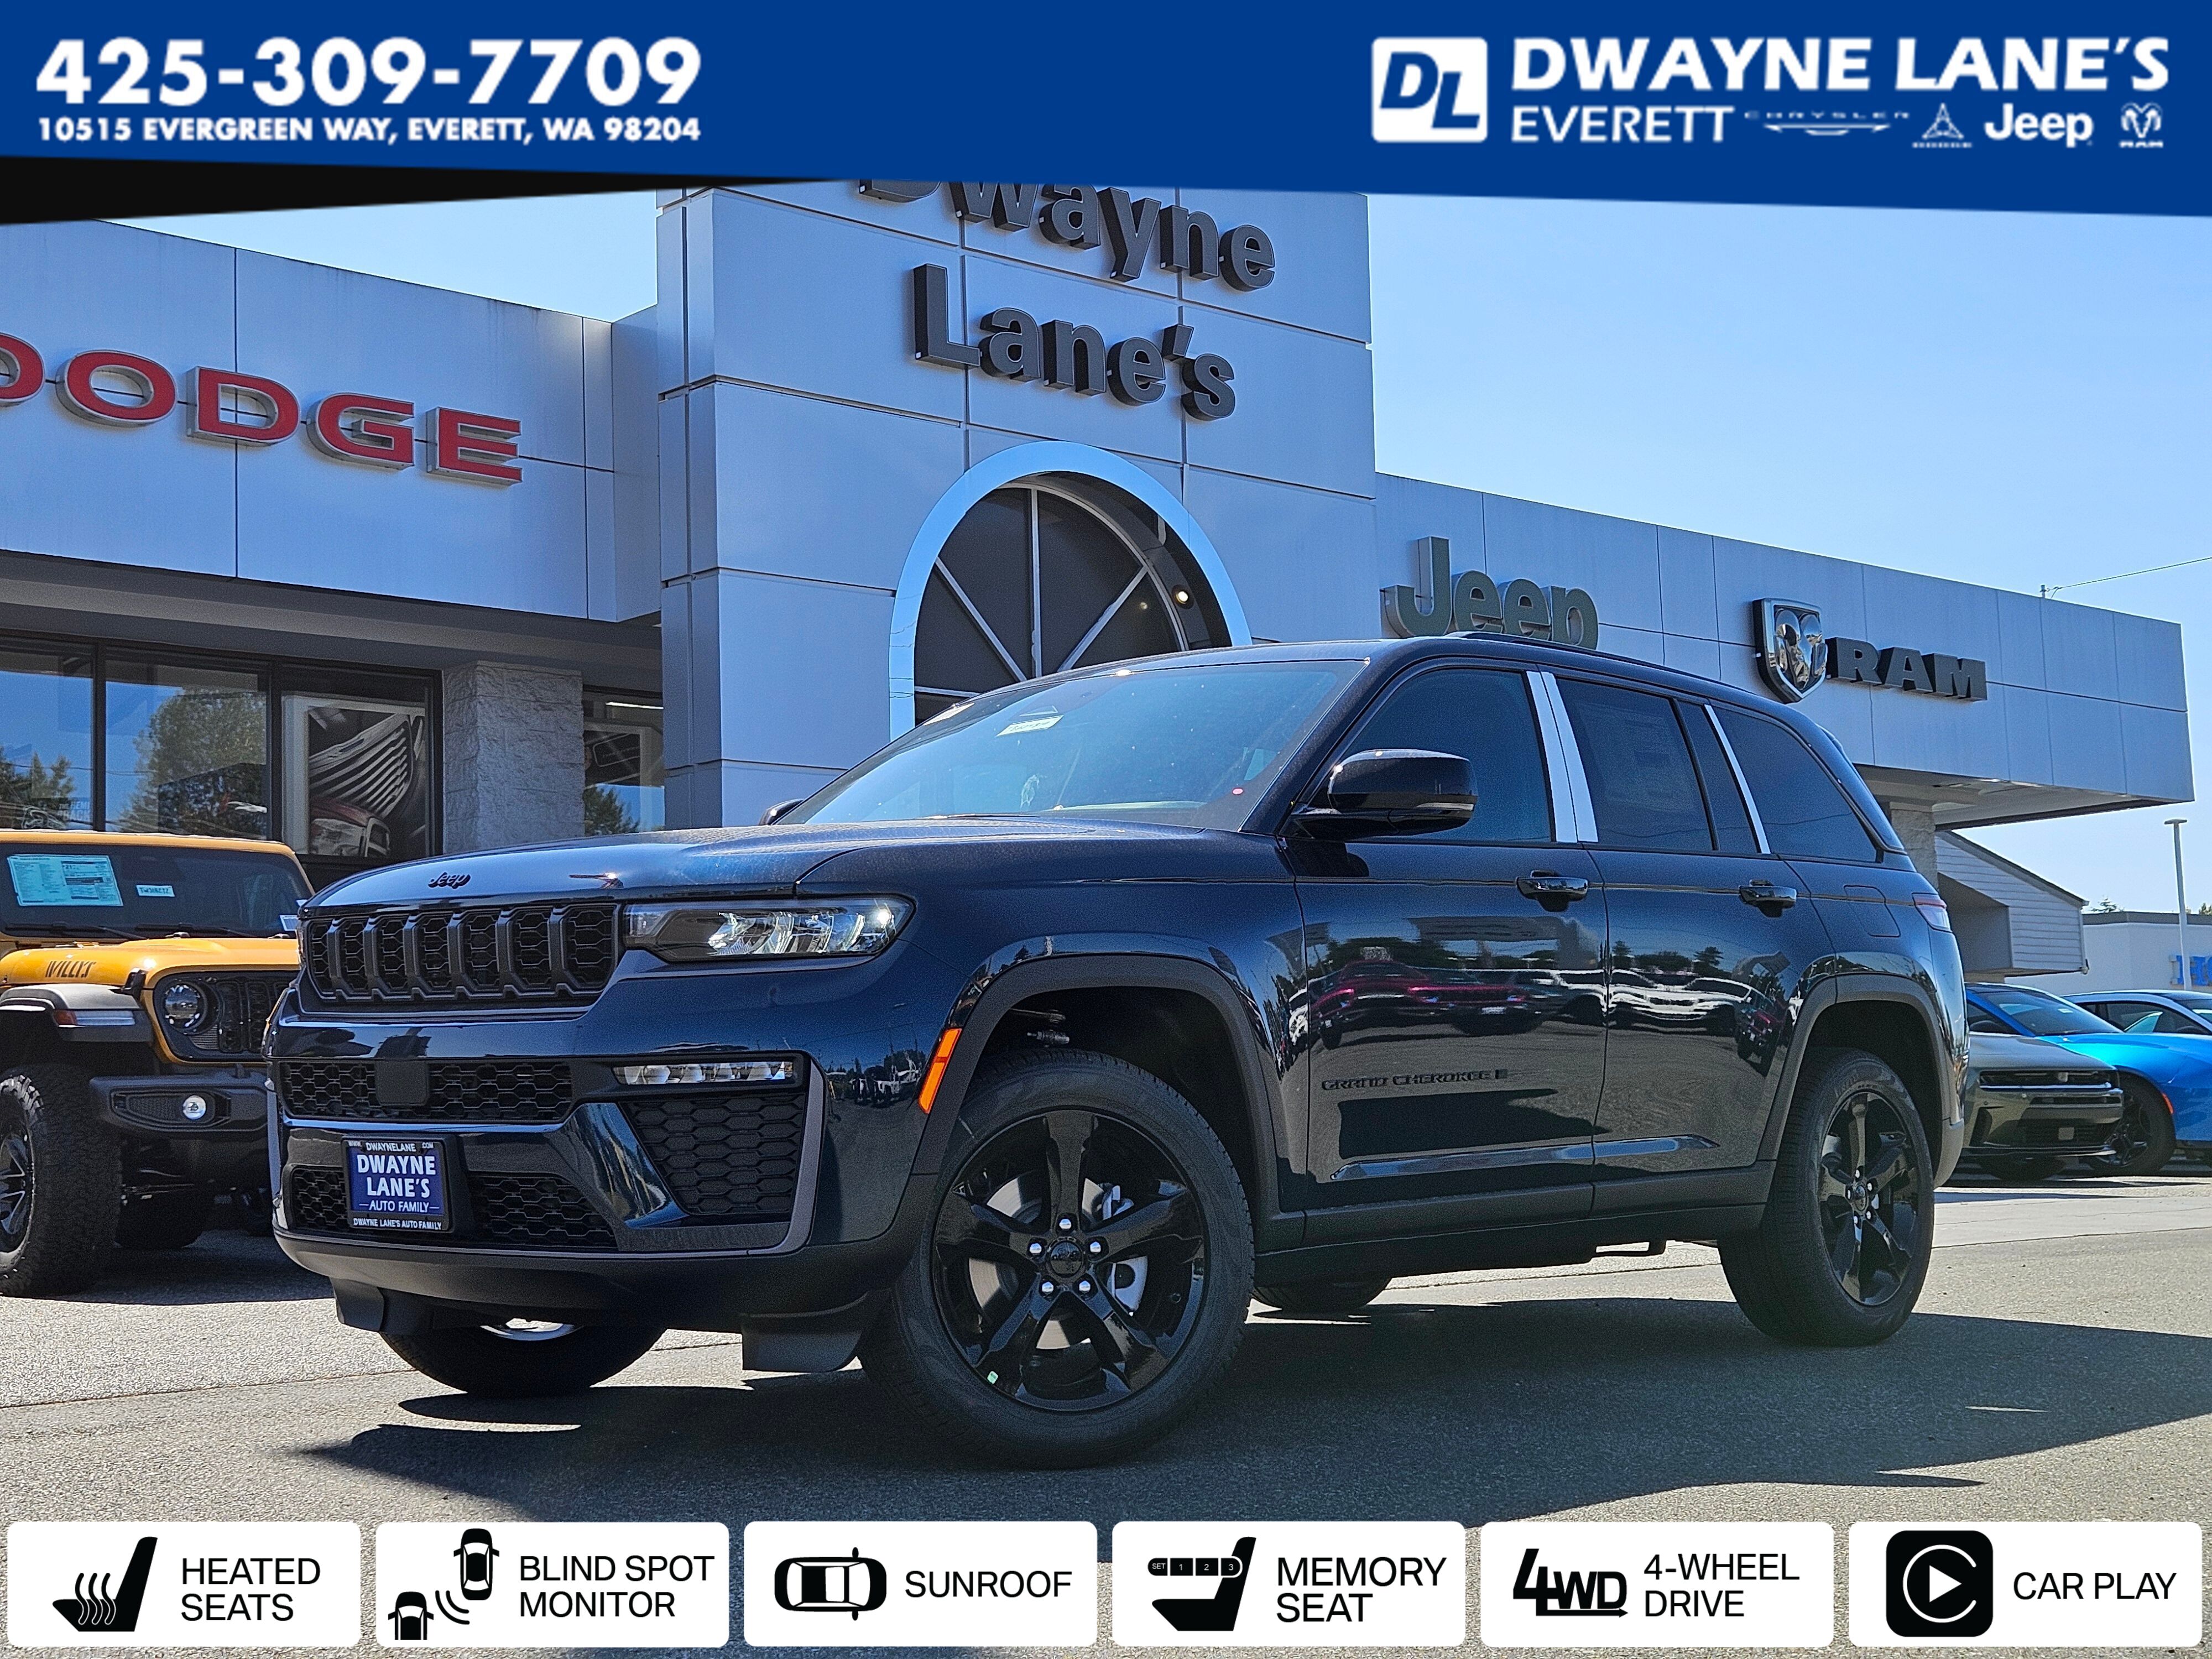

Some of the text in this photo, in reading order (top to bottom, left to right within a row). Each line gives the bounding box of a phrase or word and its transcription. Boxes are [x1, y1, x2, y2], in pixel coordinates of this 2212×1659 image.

[860, 180, 1275, 292] wayne
[914, 263, 1236, 421] Lane's
[1379, 535, 1599, 650] Jeep
[1825, 636, 1988, 702] RAM
[428, 872, 471, 889] Jeep
[45, 961, 97, 978] WILLYS
[1321, 1070, 1492, 1091] GRAND CHEROKEE
[365, 1142, 417, 1152] DWAYNELANE
[357, 1154, 436, 1175] DWAYNE
[366, 1176, 431, 1198] LANE'S
[368, 1200, 430, 1213] AUTO FAMILY
[353, 1218, 378, 1227] DWAYNE
[401, 1220, 418, 1229] AUTO
[418, 1221, 442, 1230] FAMILY
